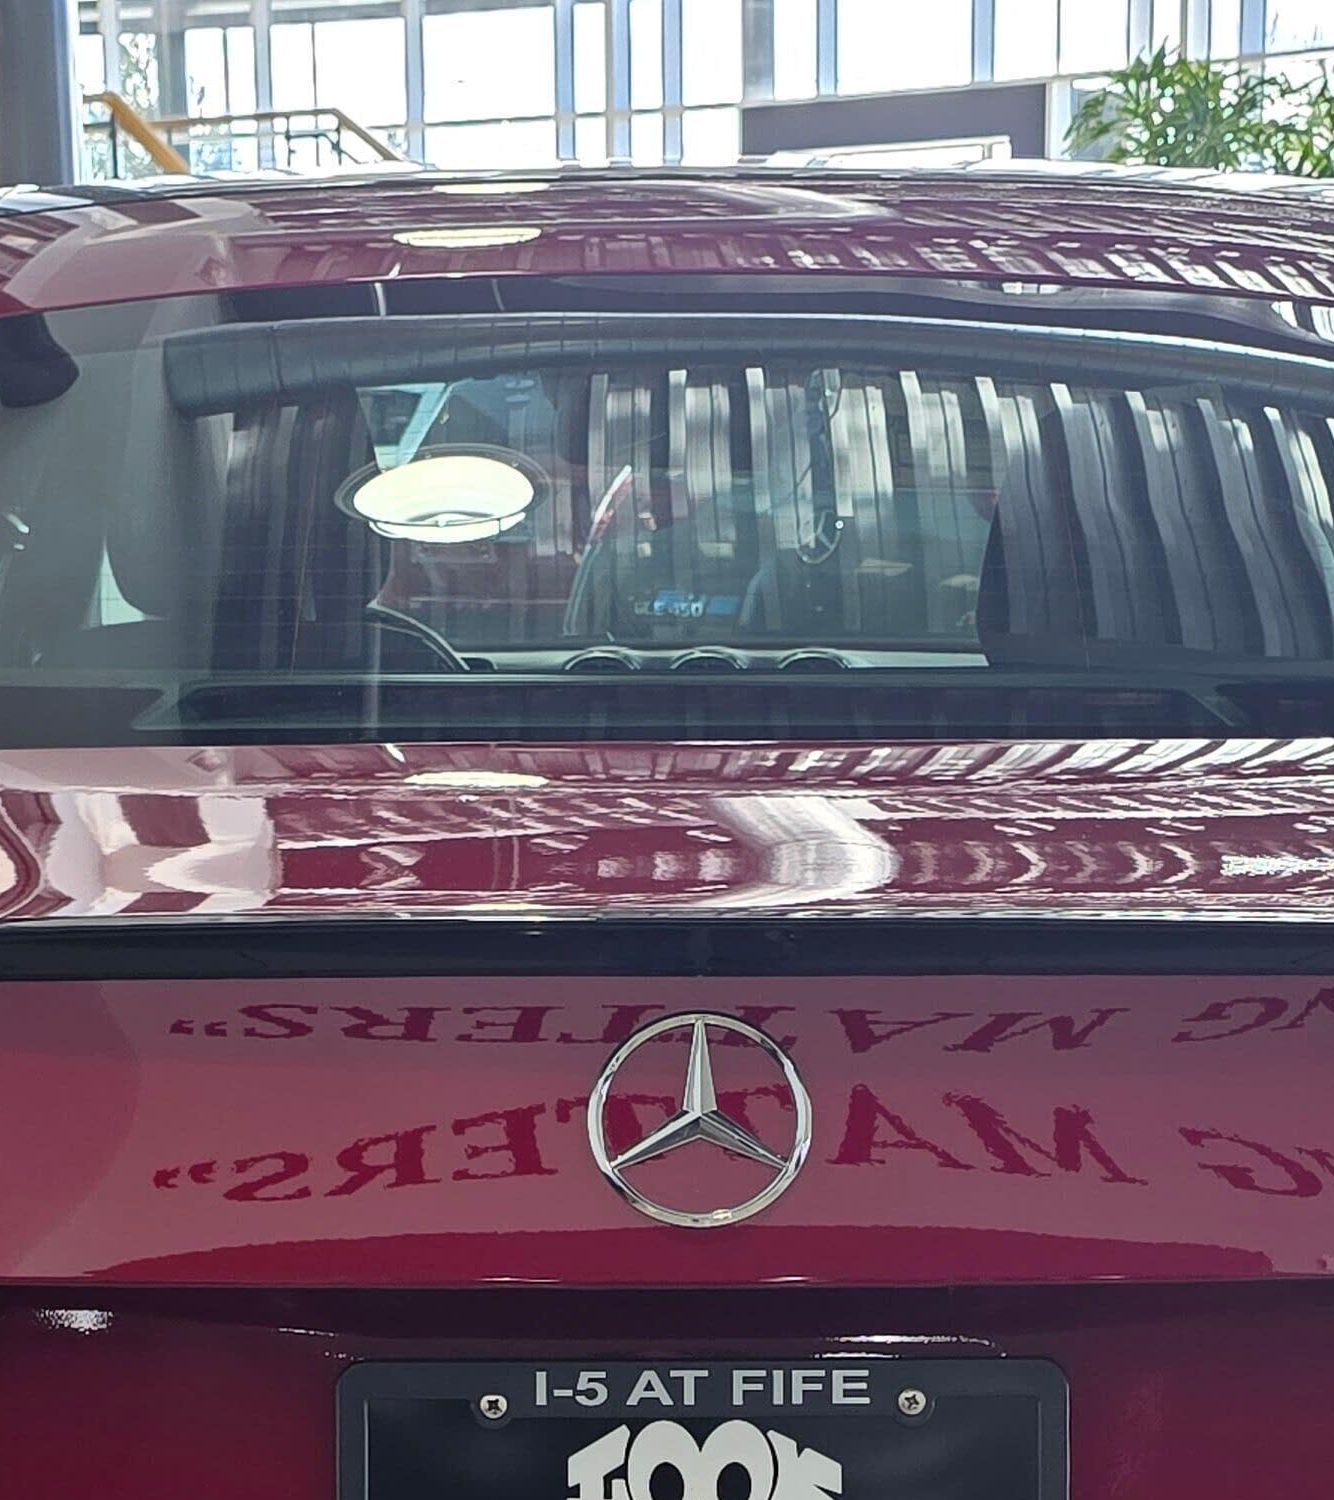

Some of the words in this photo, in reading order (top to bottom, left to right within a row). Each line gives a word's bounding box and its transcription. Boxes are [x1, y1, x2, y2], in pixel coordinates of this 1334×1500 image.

[535, 1371, 609, 1406] I-5
[627, 1370, 708, 1405] AT
[733, 1370, 871, 1406] FIFE
